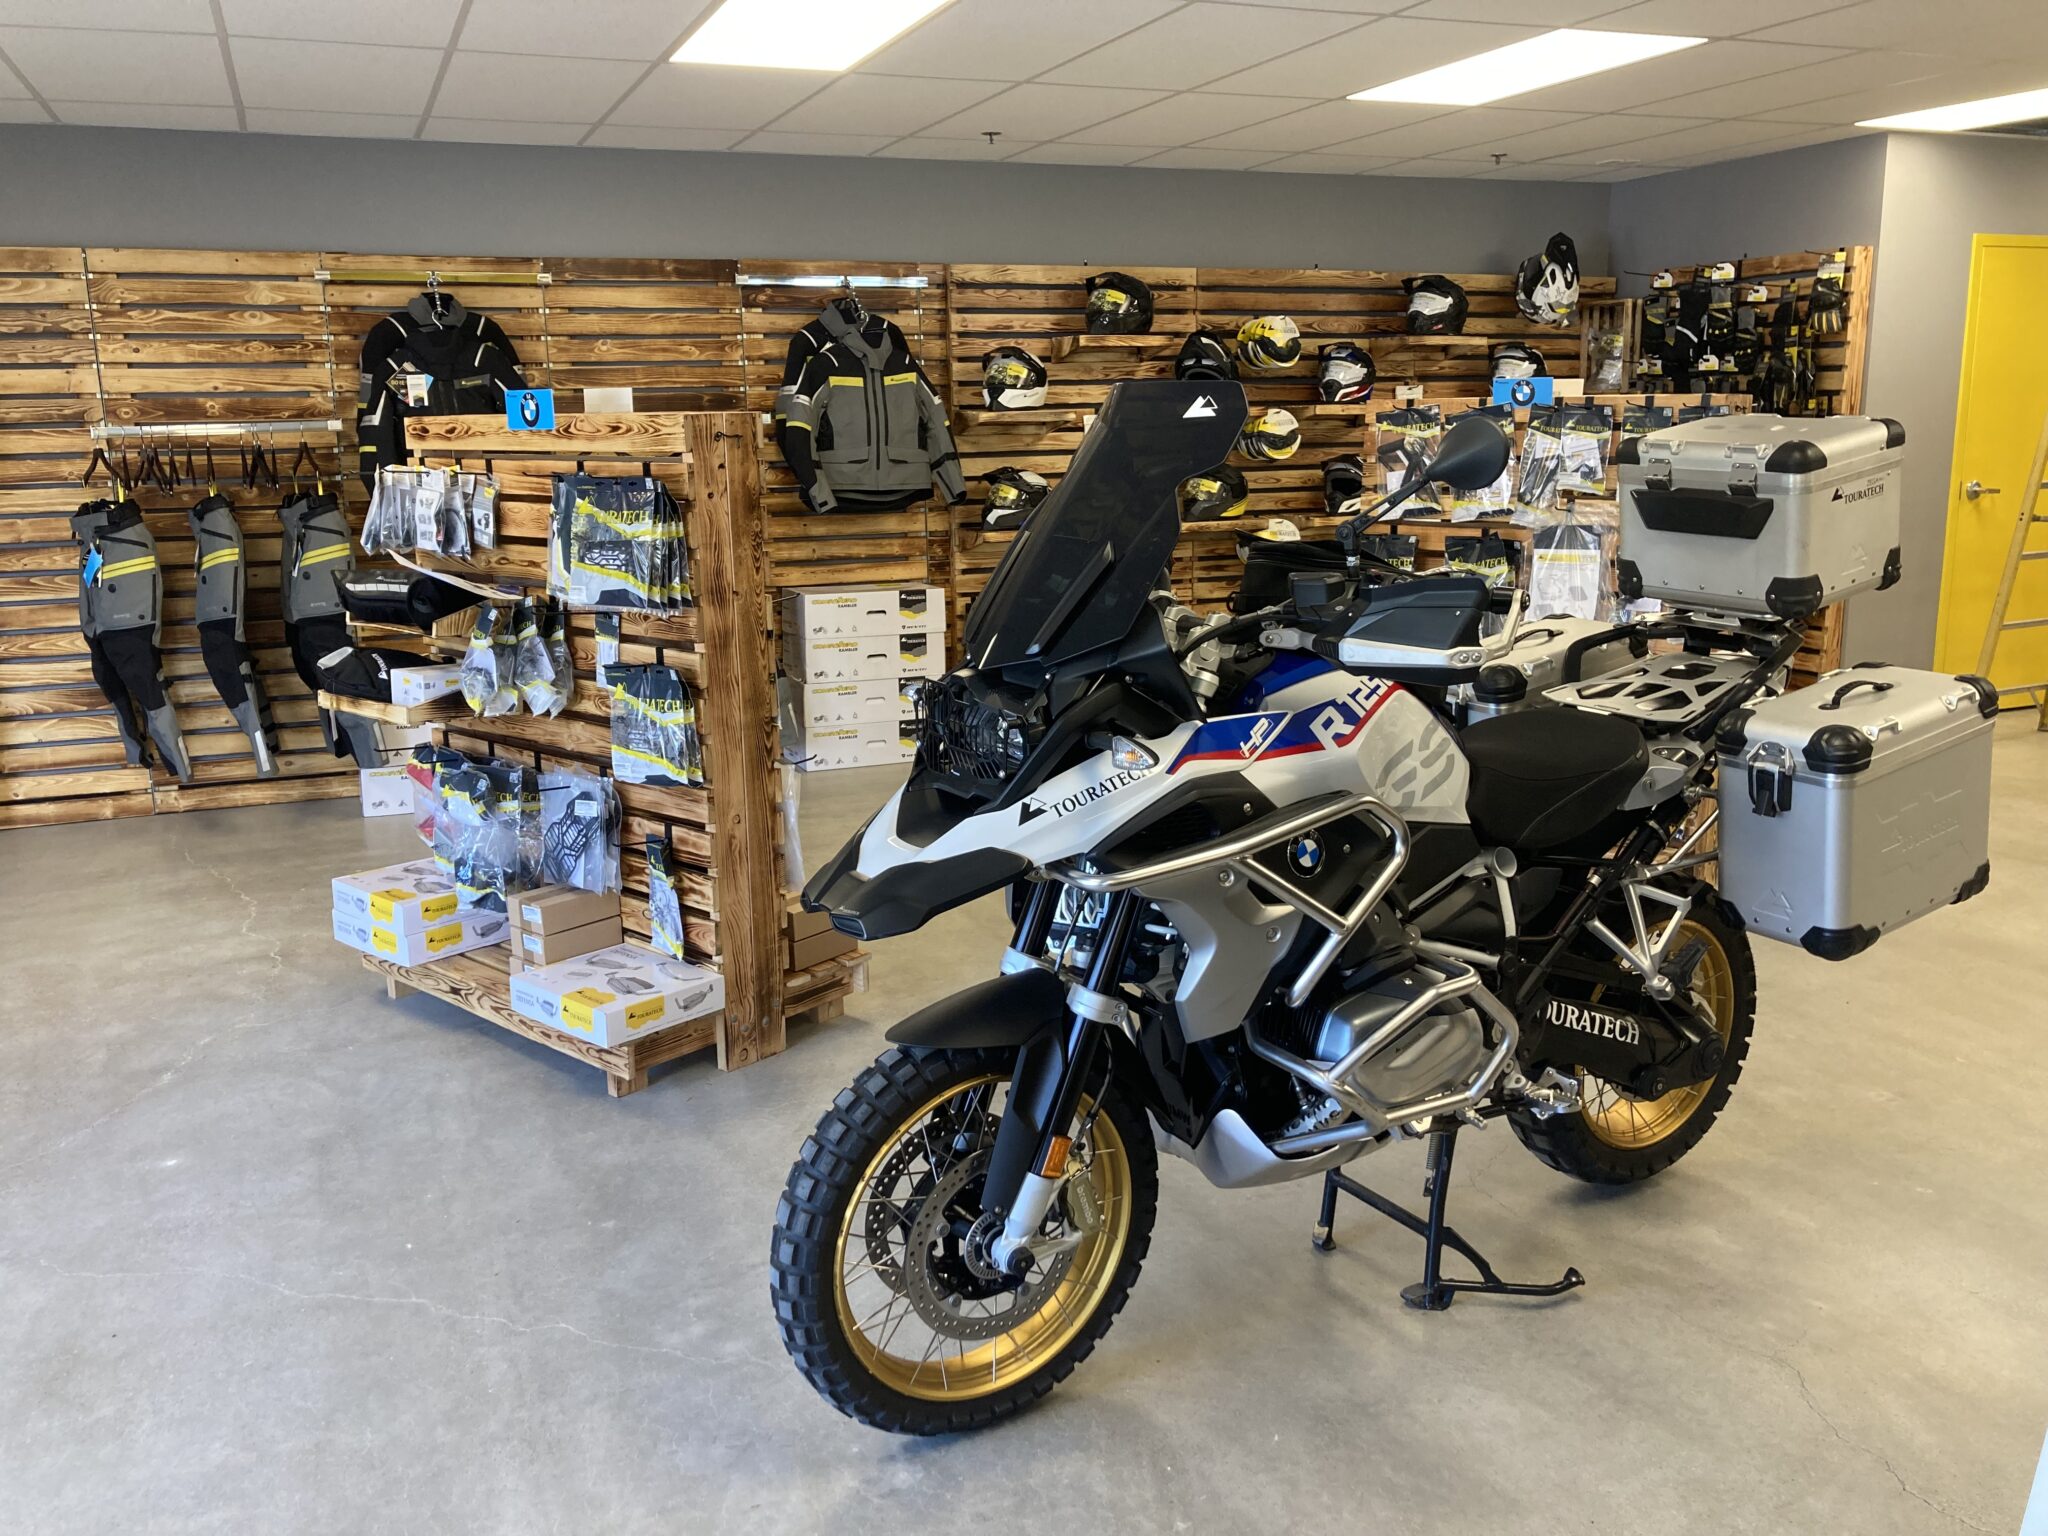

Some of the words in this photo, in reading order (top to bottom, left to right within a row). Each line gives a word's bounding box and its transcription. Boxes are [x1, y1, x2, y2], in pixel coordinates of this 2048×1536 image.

[1844, 483, 1884, 505] TOURATECH
[1309, 675, 1395, 750] R125
[1240, 718, 1273, 758] HP
[1537, 1001, 1640, 1046] URATECH
